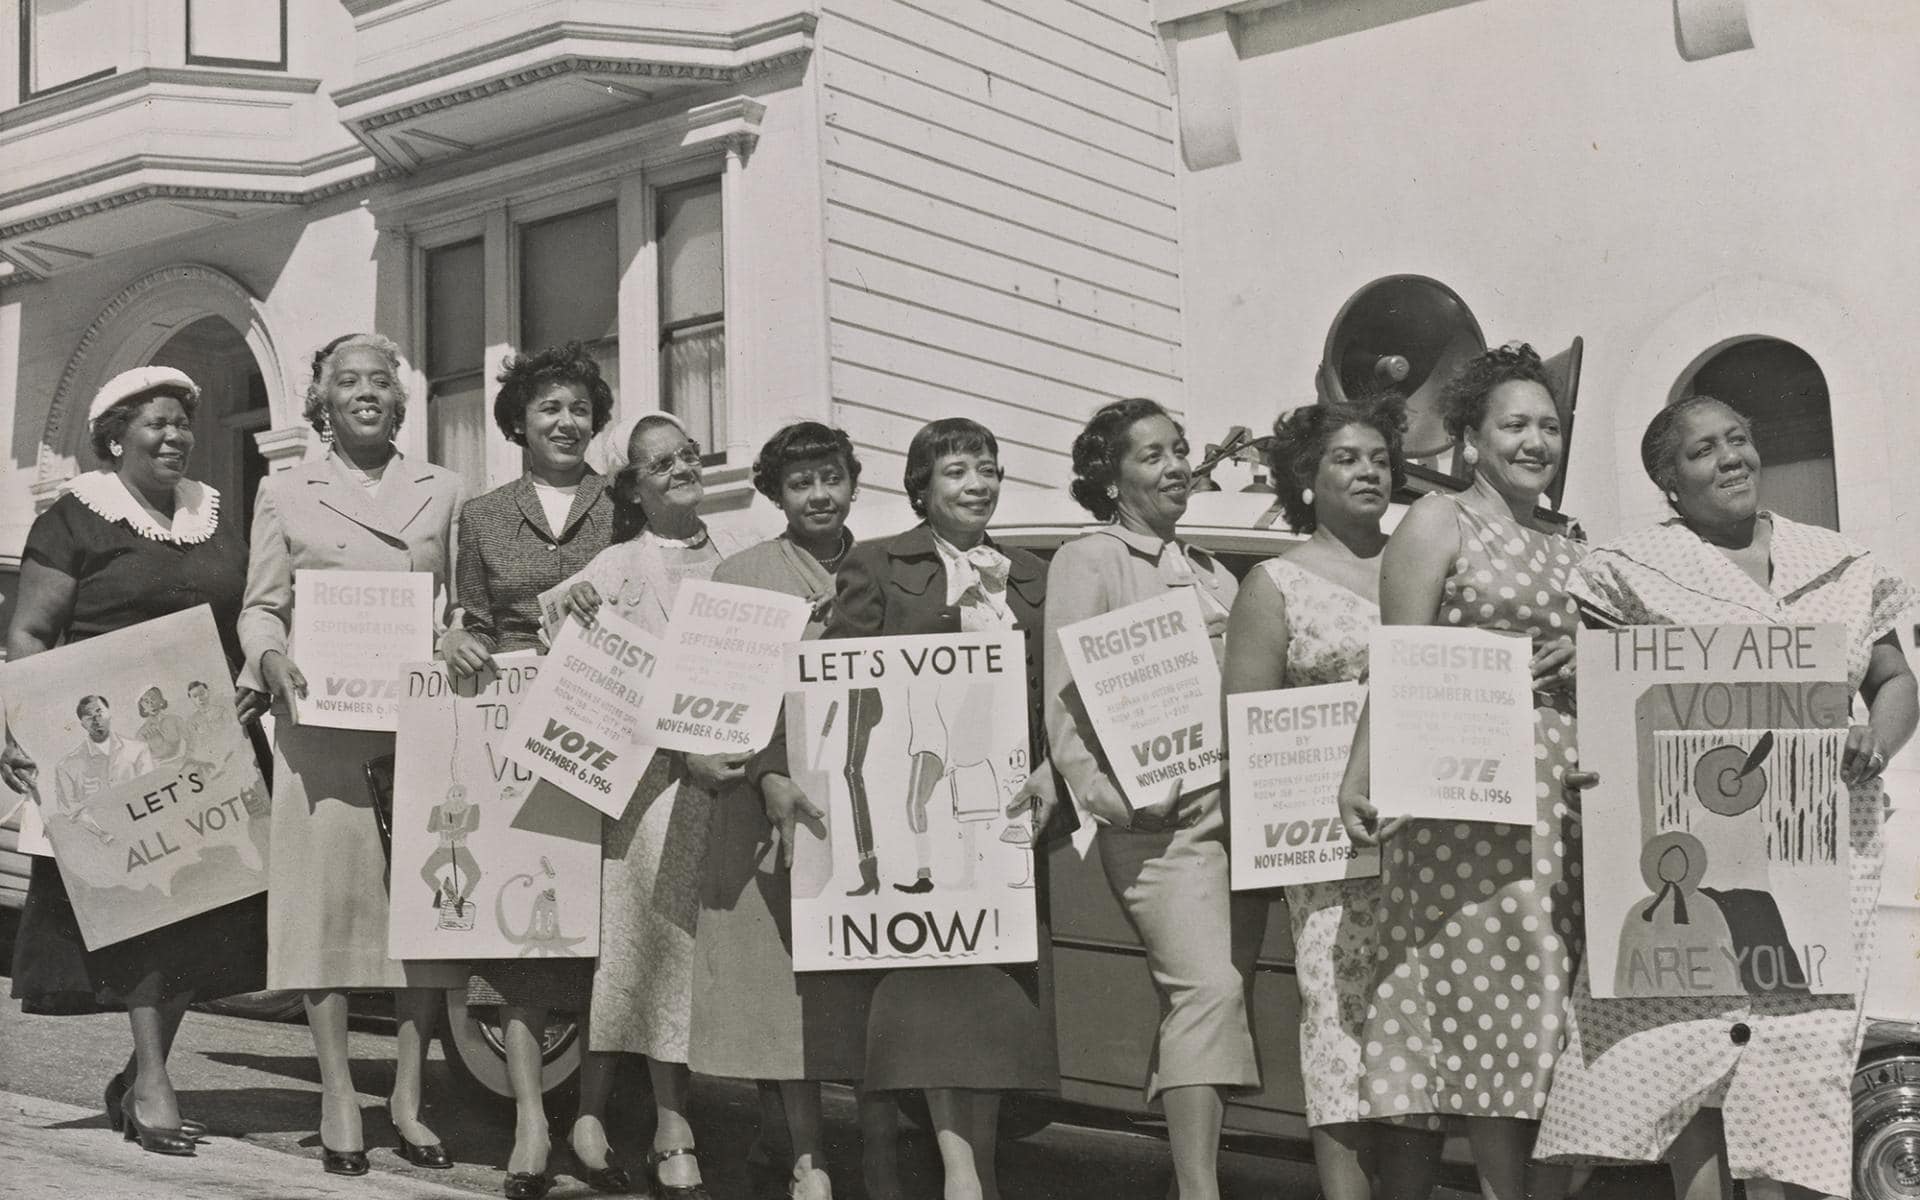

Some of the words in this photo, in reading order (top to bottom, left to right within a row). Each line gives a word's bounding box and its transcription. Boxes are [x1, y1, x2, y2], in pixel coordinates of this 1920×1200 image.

[313, 582, 416, 607] REGISTER
[689, 592, 791, 629] REGISTER
[1079, 610, 1187, 664] REGISTER
[1607, 626, 1719, 671] THEY
[1732, 627, 1816, 670] ARE
[799, 650, 885, 682] LET'S
[900, 645, 1003, 676] VOTE
[1131, 654, 1146, 666] BY
[1392, 640, 1512, 672] REGISTER
[326, 677, 400, 698] VOTE
[563, 655, 627, 698] SEPTEMBER
[610, 665, 625, 680] BY
[1095, 664, 1162, 696] SEPTEMBER
[316, 699, 375, 713] NOVEMBER
[672, 693, 749, 724] VOTE
[1391, 685, 1472, 703] SEPTEMBER
[1664, 681, 1837, 730] VOTING
[476, 704, 508, 731] TO
[656, 718, 712, 739] NOVEMBER
[1247, 701, 1358, 736] REGISTER
[524, 737, 578, 775] NOVEMBER
[543, 718, 619, 771] VOTE
[1131, 722, 1203, 767] VOTE
[1296, 736, 1311, 746] BY
[1136, 760, 1187, 788] NOVEMBER
[1248, 748, 1321, 769] SEPTEMBER
[126, 773, 204, 821] LET'S
[1264, 817, 1346, 848] VOTE
[127, 832, 180, 872] ALL
[1254, 850, 1316, 869] NOVEMBER
[1629, 947, 1714, 990] ARE
[1720, 944, 1827, 990] YOU?
